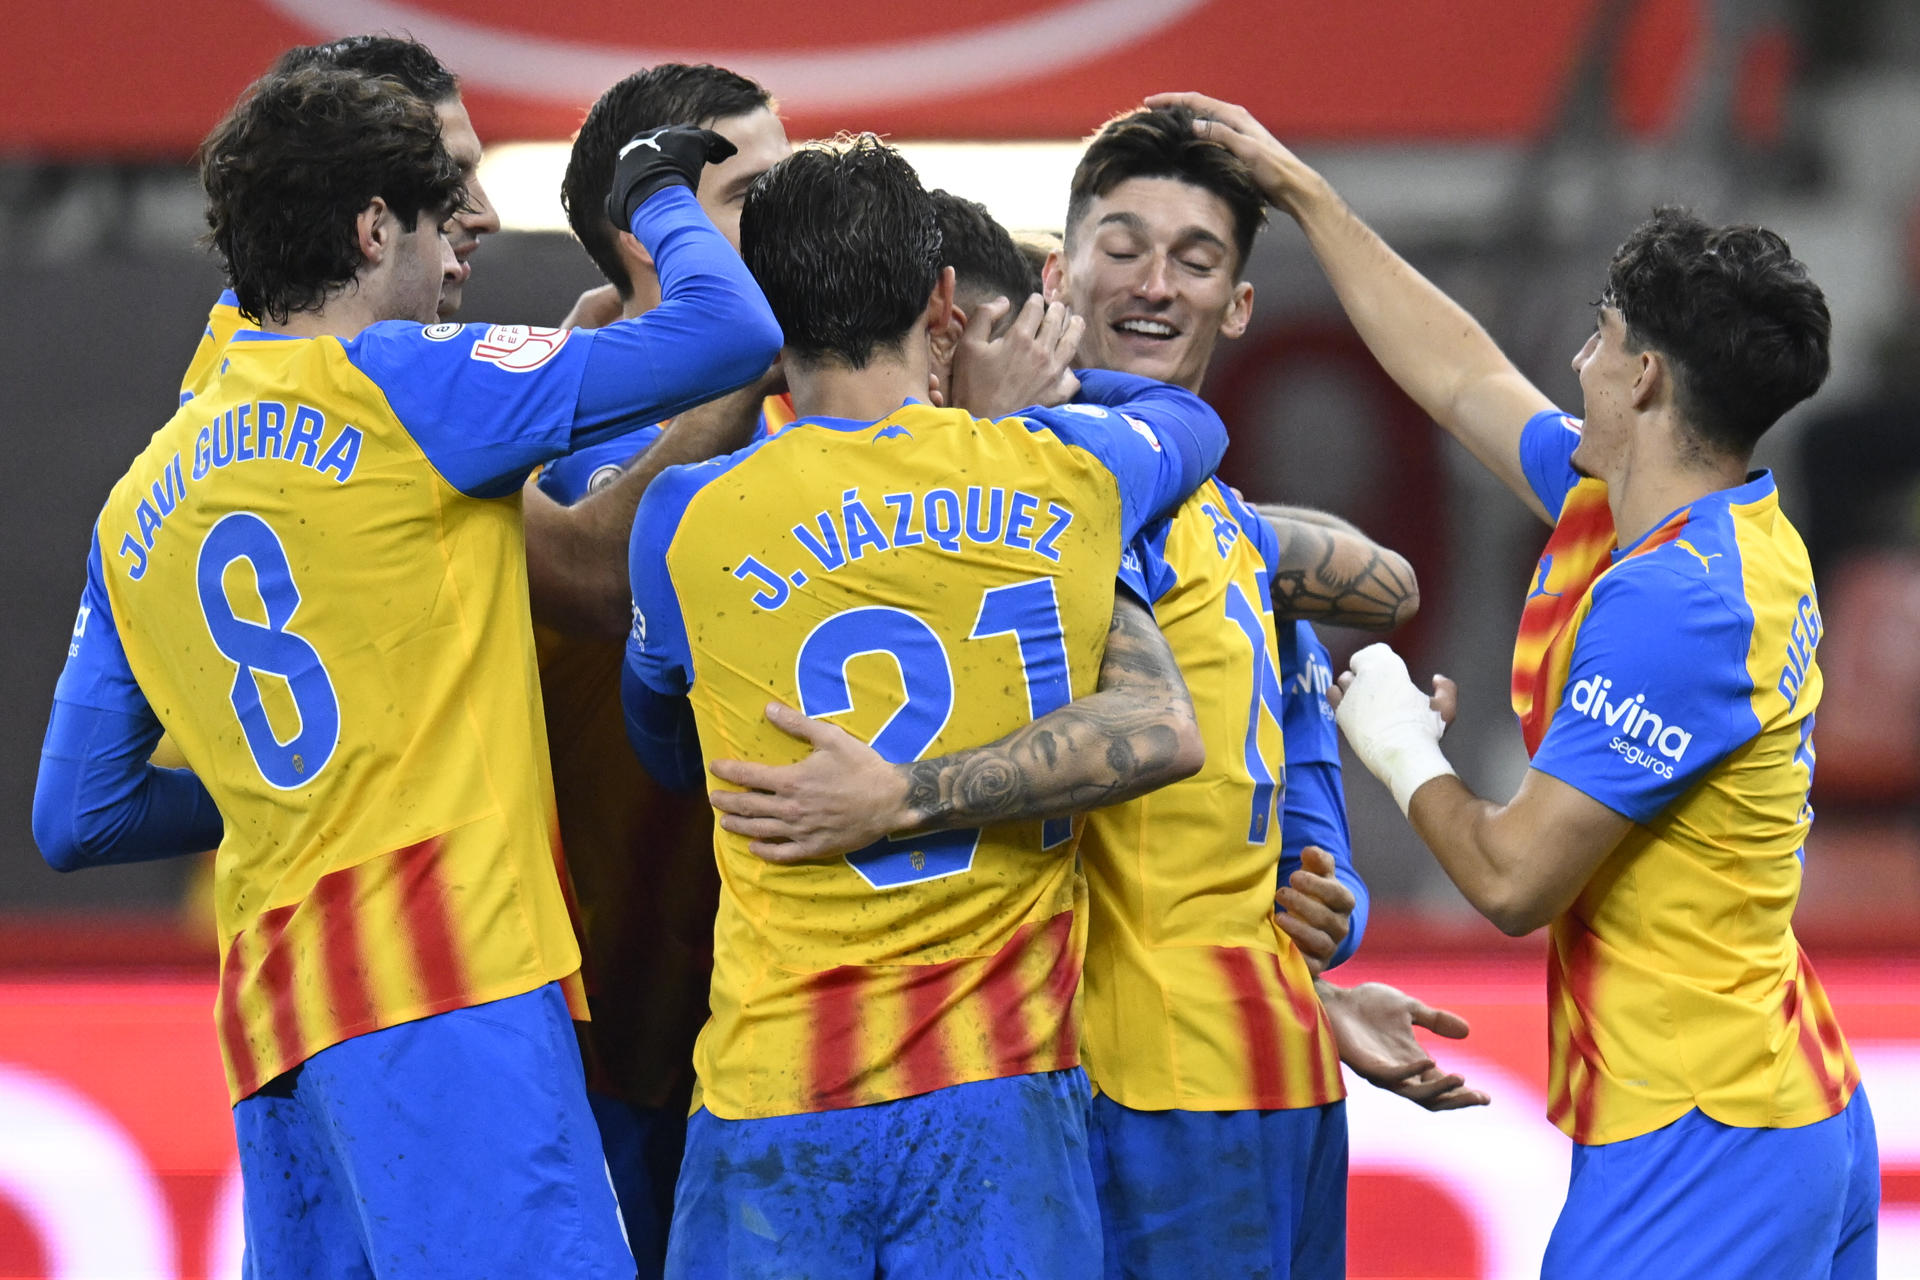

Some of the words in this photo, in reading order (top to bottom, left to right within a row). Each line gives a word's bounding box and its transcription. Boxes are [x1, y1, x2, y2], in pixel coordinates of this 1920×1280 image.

[119, 450, 187, 581] JAVI
[191, 400, 364, 483] GUERRA
[732, 555, 809, 611] J.
[791, 486, 1074, 573] VÁZQUEZ
[196, 510, 341, 790] 8
[1777, 580, 1824, 716] DIEG
[796, 576, 1074, 890] 21
[1571, 674, 1693, 763] divina
[1609, 736, 1674, 779] seguros
